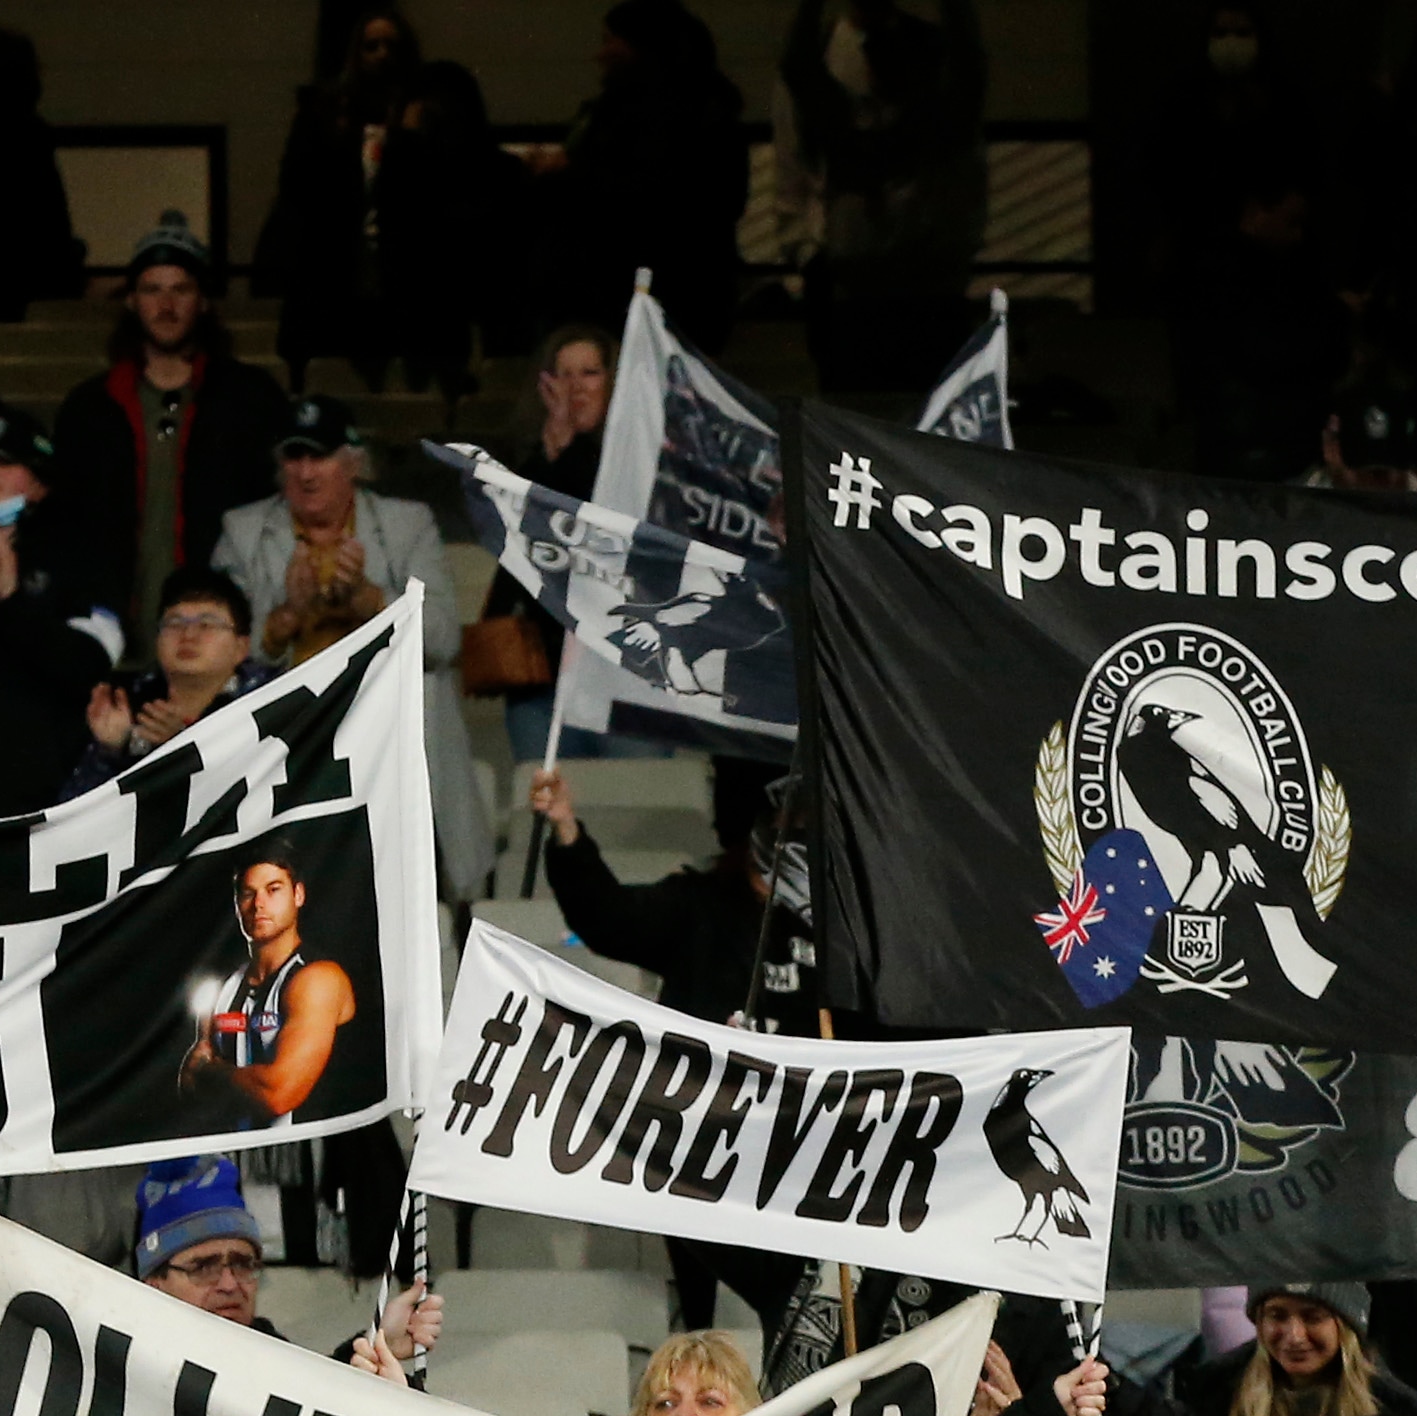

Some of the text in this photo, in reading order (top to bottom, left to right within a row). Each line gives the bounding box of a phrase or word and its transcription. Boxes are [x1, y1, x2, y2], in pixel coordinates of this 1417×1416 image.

[1177, 635, 1294, 777] FOOTBALL
[1278, 780, 1311, 852] CLUB
[1177, 940, 1214, 960] 1892
[1179, 918, 1213, 939] EST
[444, 990, 964, 1233] #FOREVER
[1126, 1126, 1207, 1165] 1892
[1124, 1158, 1336, 1242] INGWOOD
